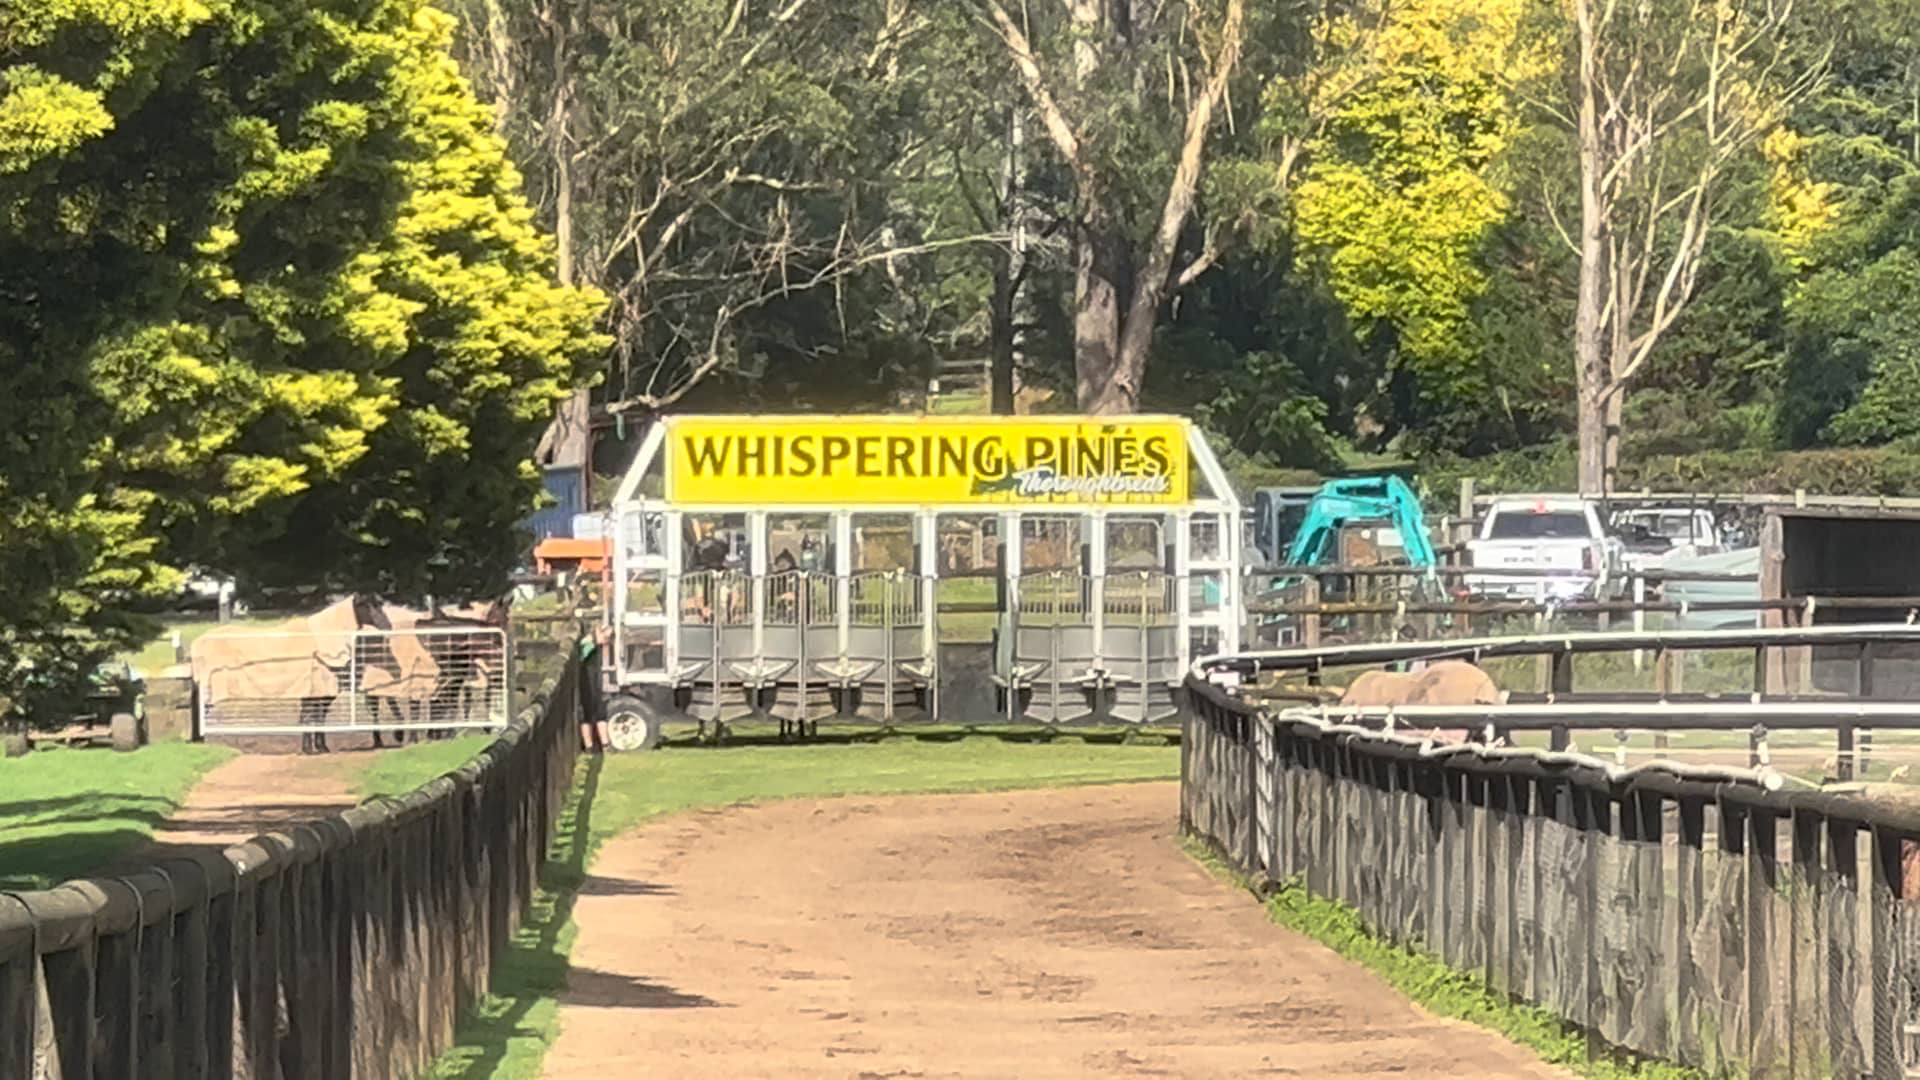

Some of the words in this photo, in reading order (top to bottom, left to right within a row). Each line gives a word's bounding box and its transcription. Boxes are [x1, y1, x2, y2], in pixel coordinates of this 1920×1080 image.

[683, 435, 1004, 478] WHISPERING
[1025, 436, 1170, 478] PINES
[1015, 468, 1169, 496] Thoroughbreds
